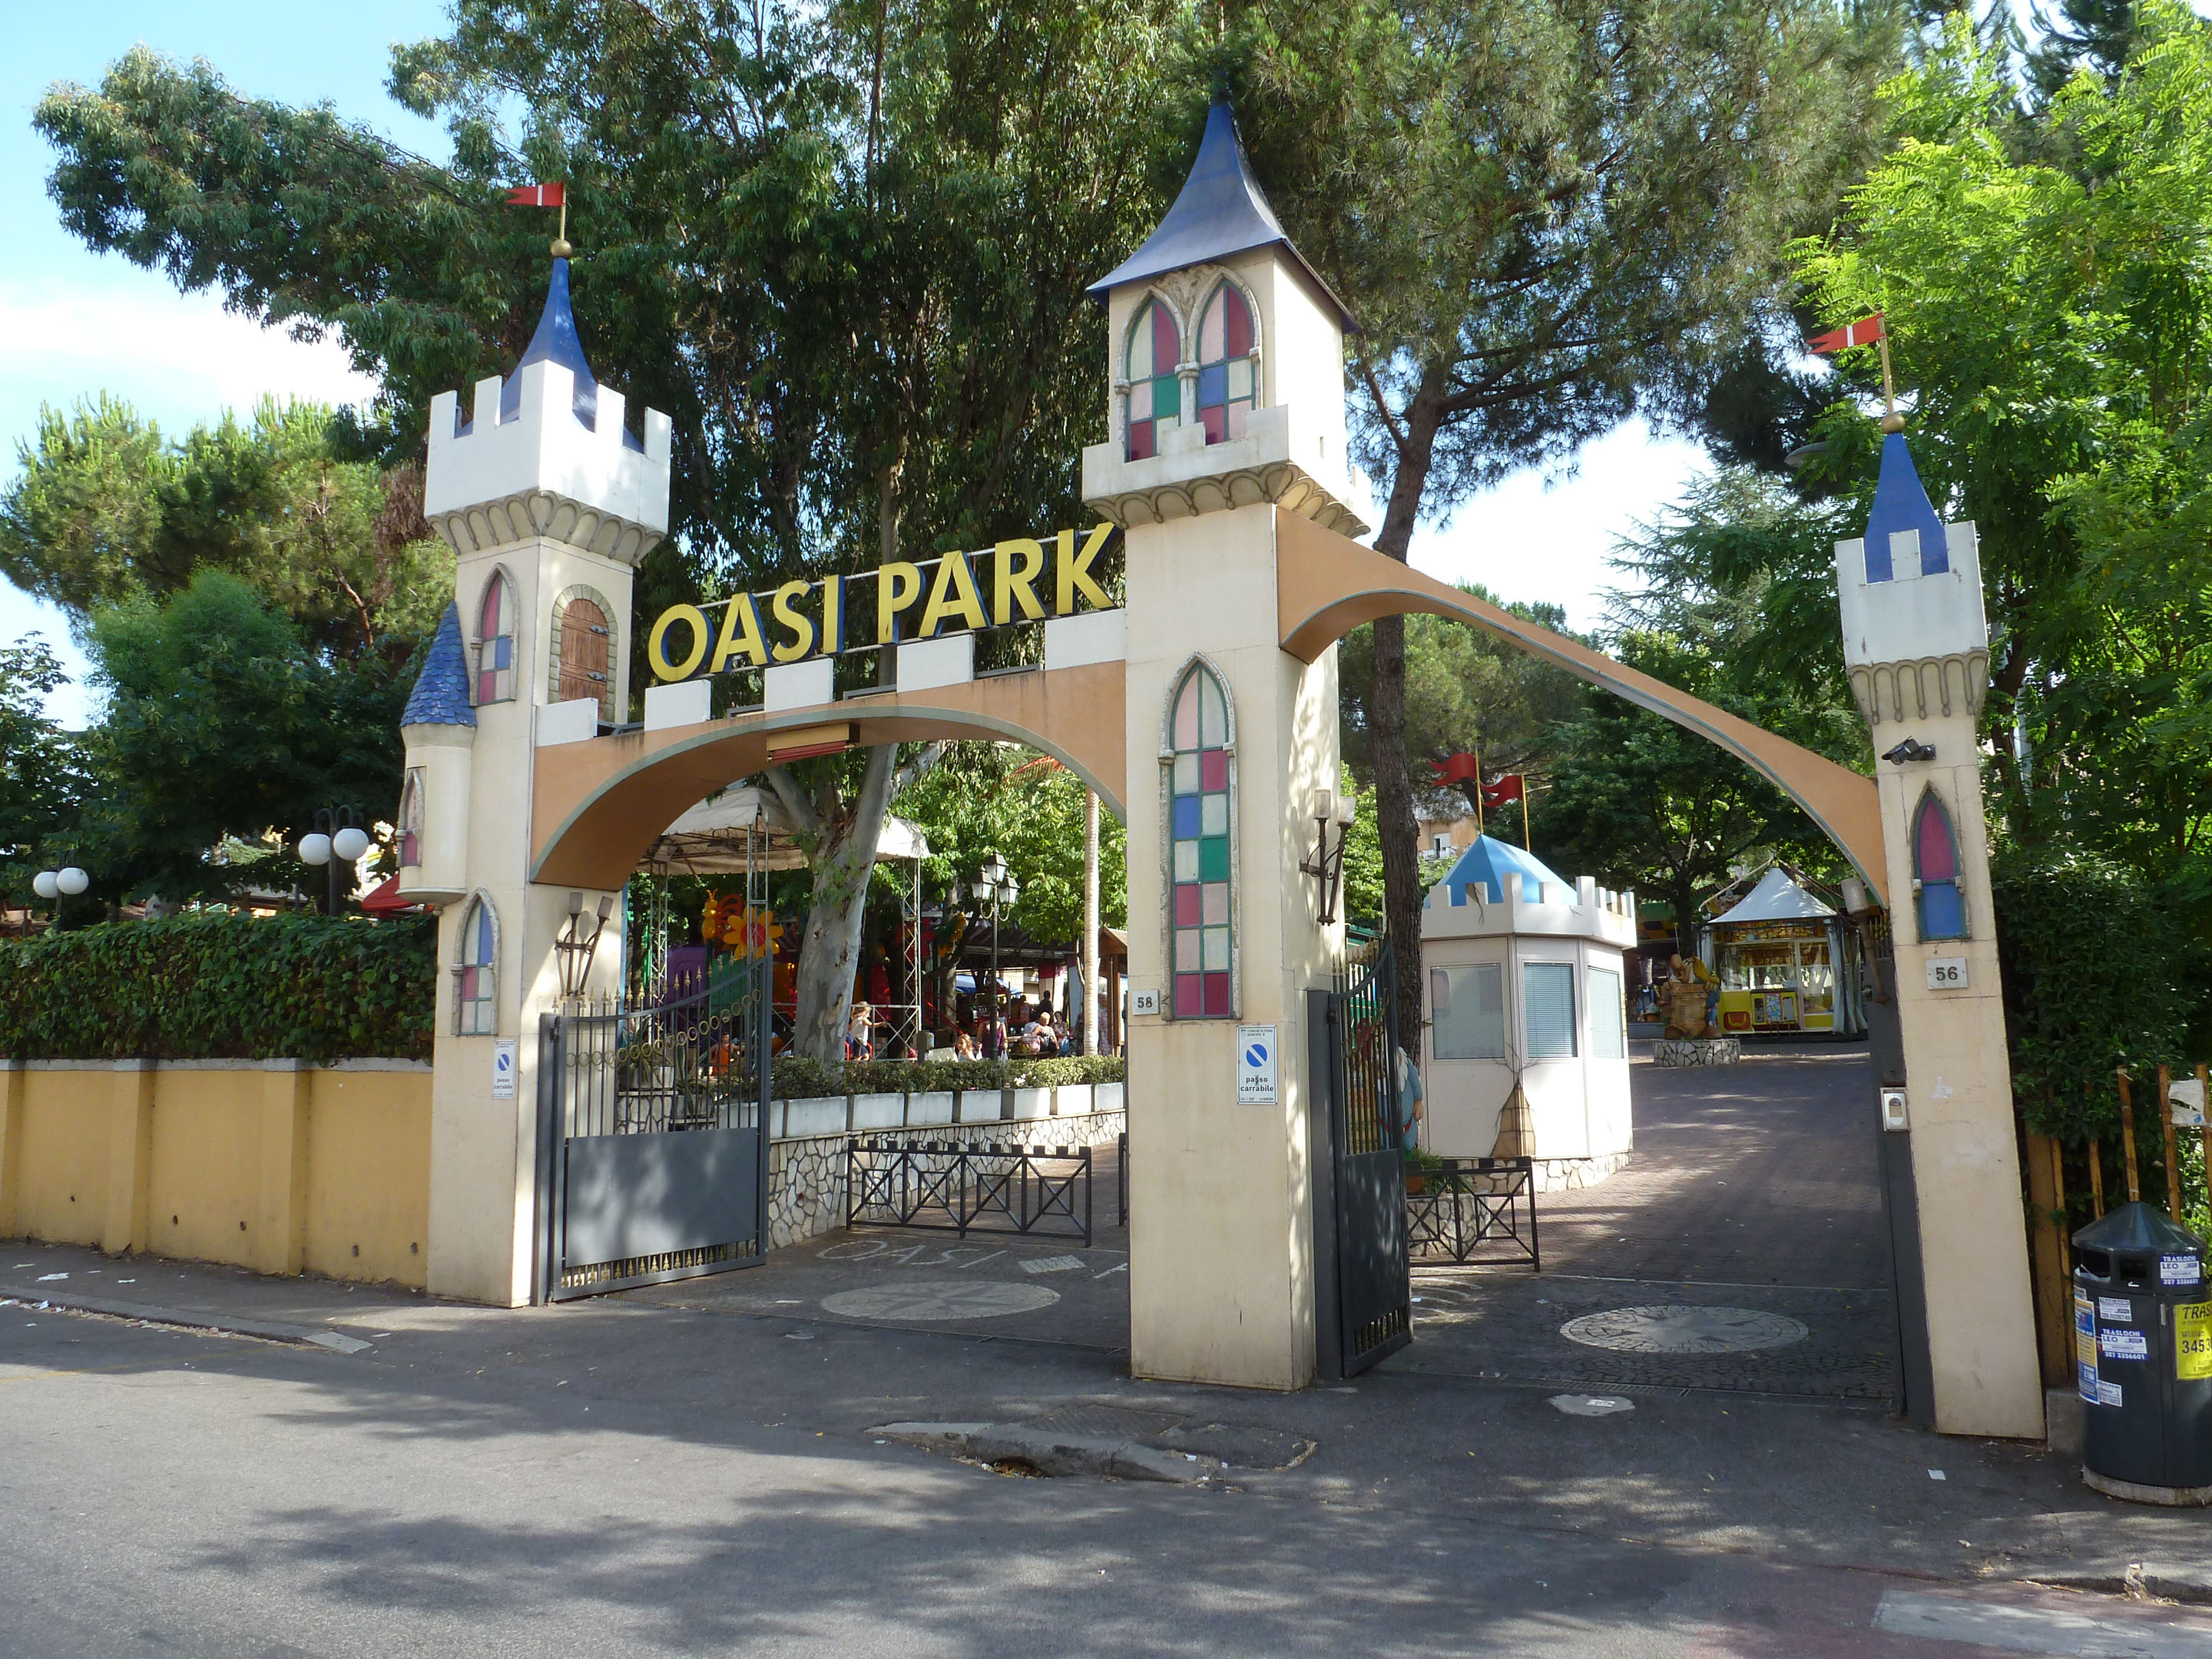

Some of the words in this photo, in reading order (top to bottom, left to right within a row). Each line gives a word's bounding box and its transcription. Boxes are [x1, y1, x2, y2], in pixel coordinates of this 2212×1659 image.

[648, 575, 844, 682] OASI
[878, 522, 1121, 644] PARK
[1935, 966, 1959, 981] 56
[1137, 996, 1153, 1008] 58
[815, 1240, 1009, 1269] OASI
